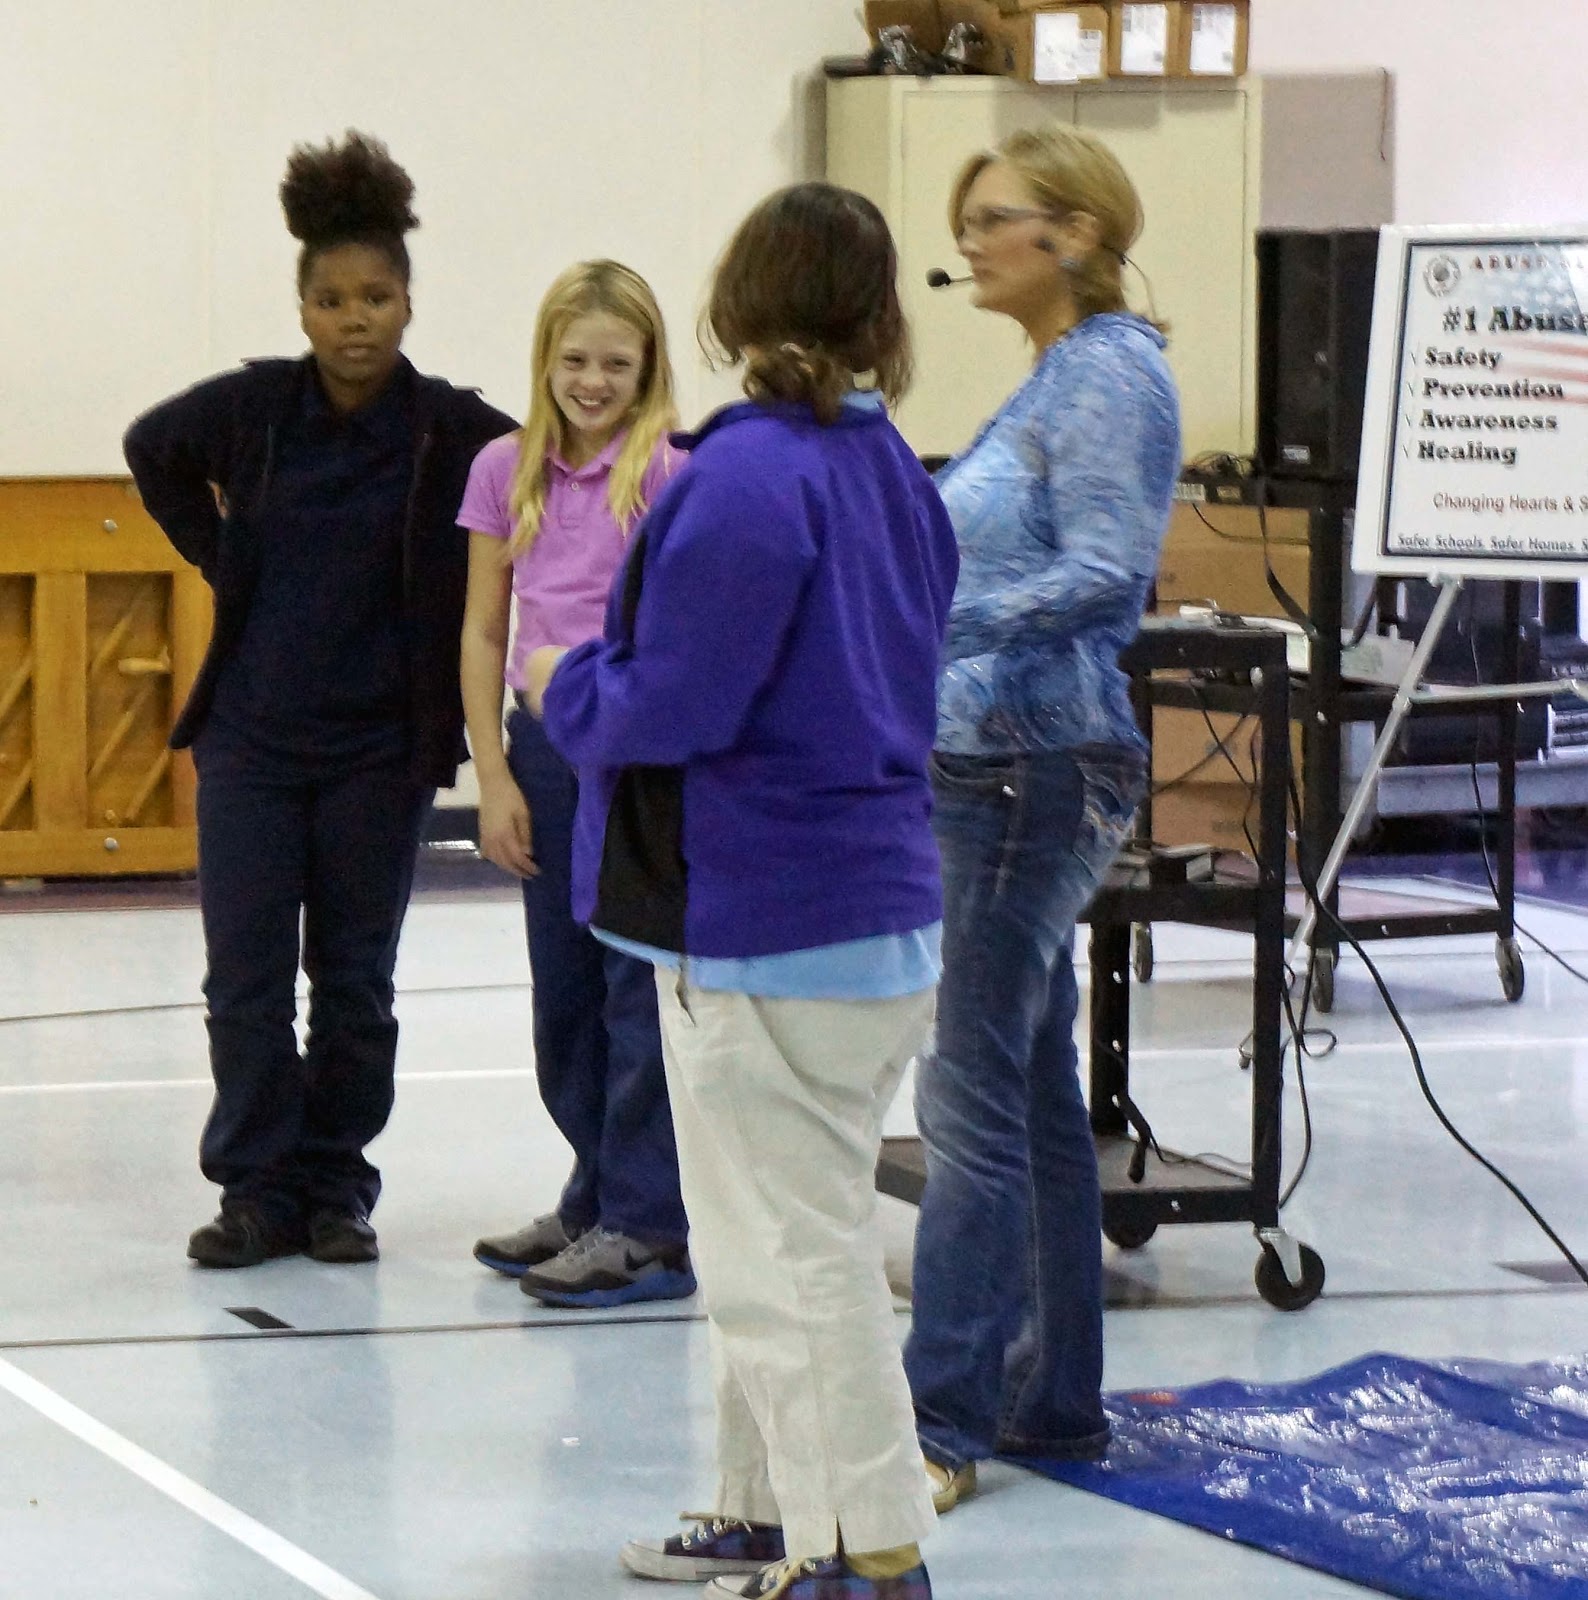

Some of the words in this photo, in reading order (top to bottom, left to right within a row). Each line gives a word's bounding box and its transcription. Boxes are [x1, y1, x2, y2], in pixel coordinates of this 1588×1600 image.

[1443, 304, 1476, 332] #1
[1425, 346, 1501, 369] Safety
[1422, 377, 1564, 398] Prevention
[1420, 408, 1558, 431] Awareness
[1417, 439, 1518, 466] Healing
[1433, 492, 1504, 513] Changing
[1510, 494, 1558, 511] Hearts
[1563, 495, 1574, 513] &
[1398, 532, 1429, 547] Safer
[1491, 534, 1524, 550] Safer
